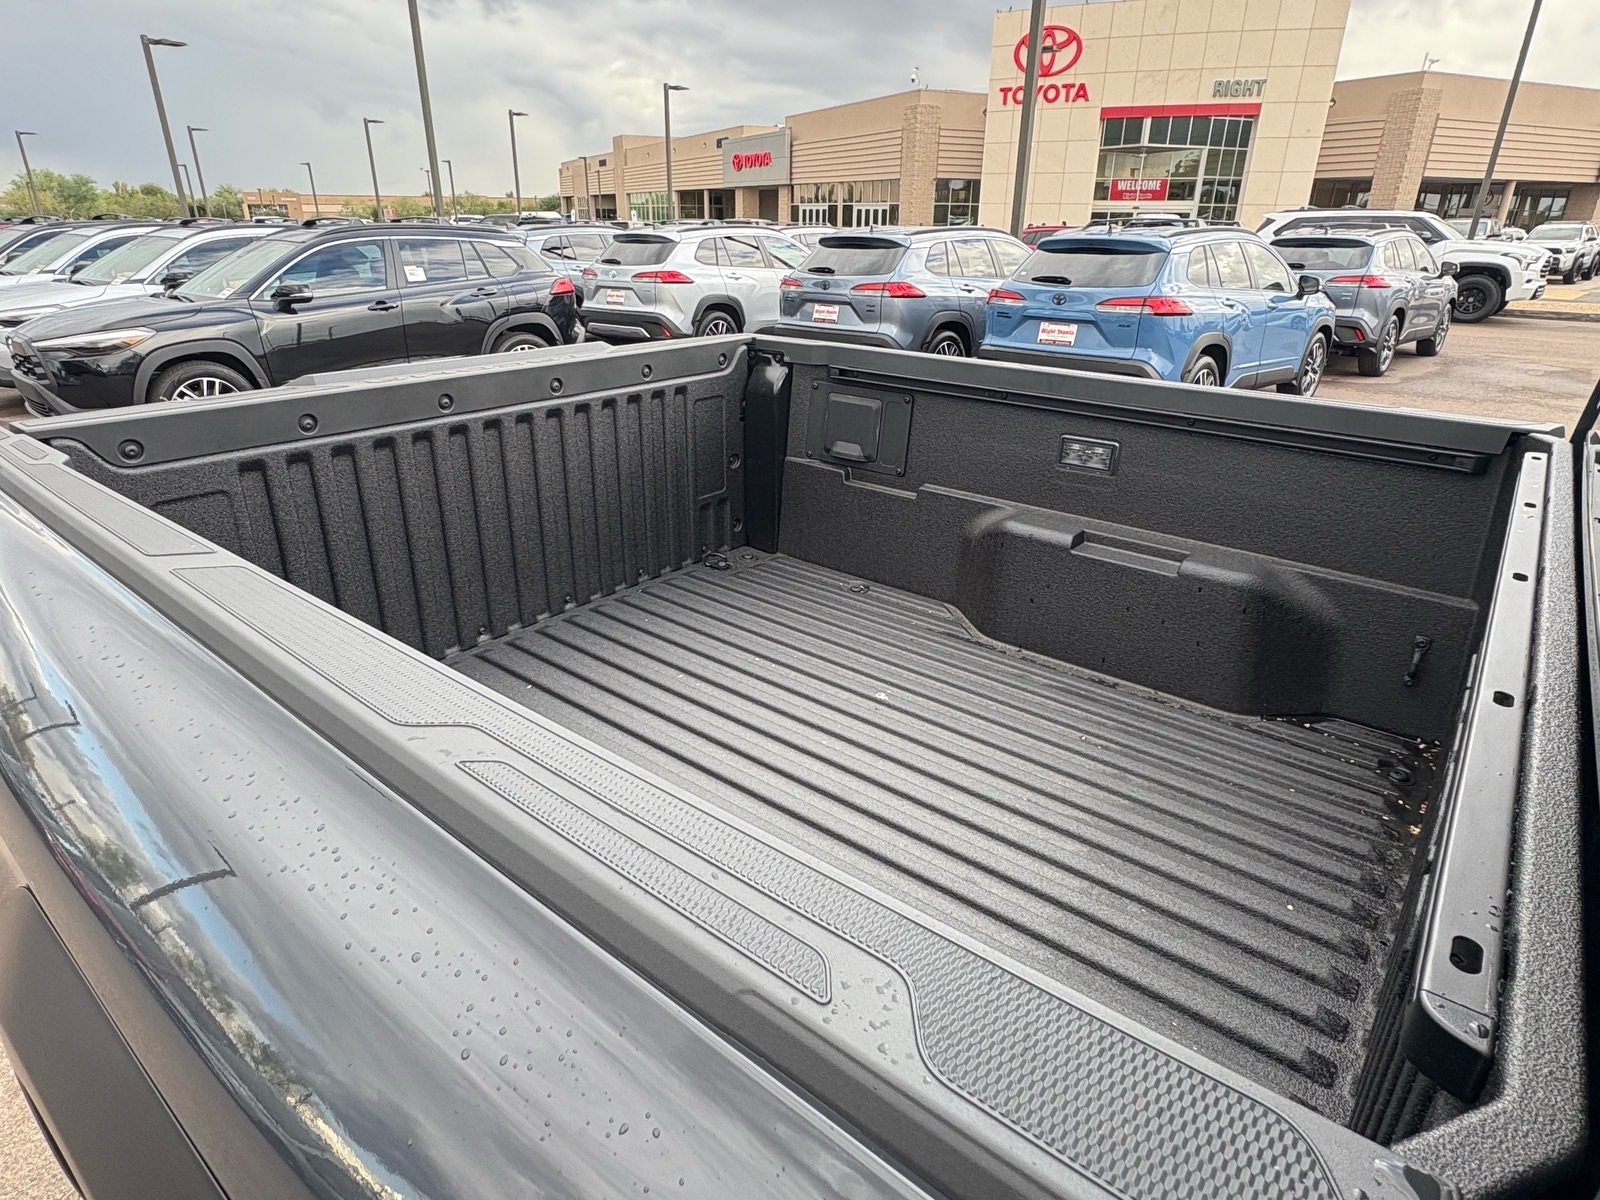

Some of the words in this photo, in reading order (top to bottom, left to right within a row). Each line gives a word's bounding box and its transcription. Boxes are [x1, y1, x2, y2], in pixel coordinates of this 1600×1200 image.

[1212, 79, 1268, 98] RIGHT
[741, 152, 772, 169] TOYOTA
[1117, 180, 1162, 191] WELCOME
